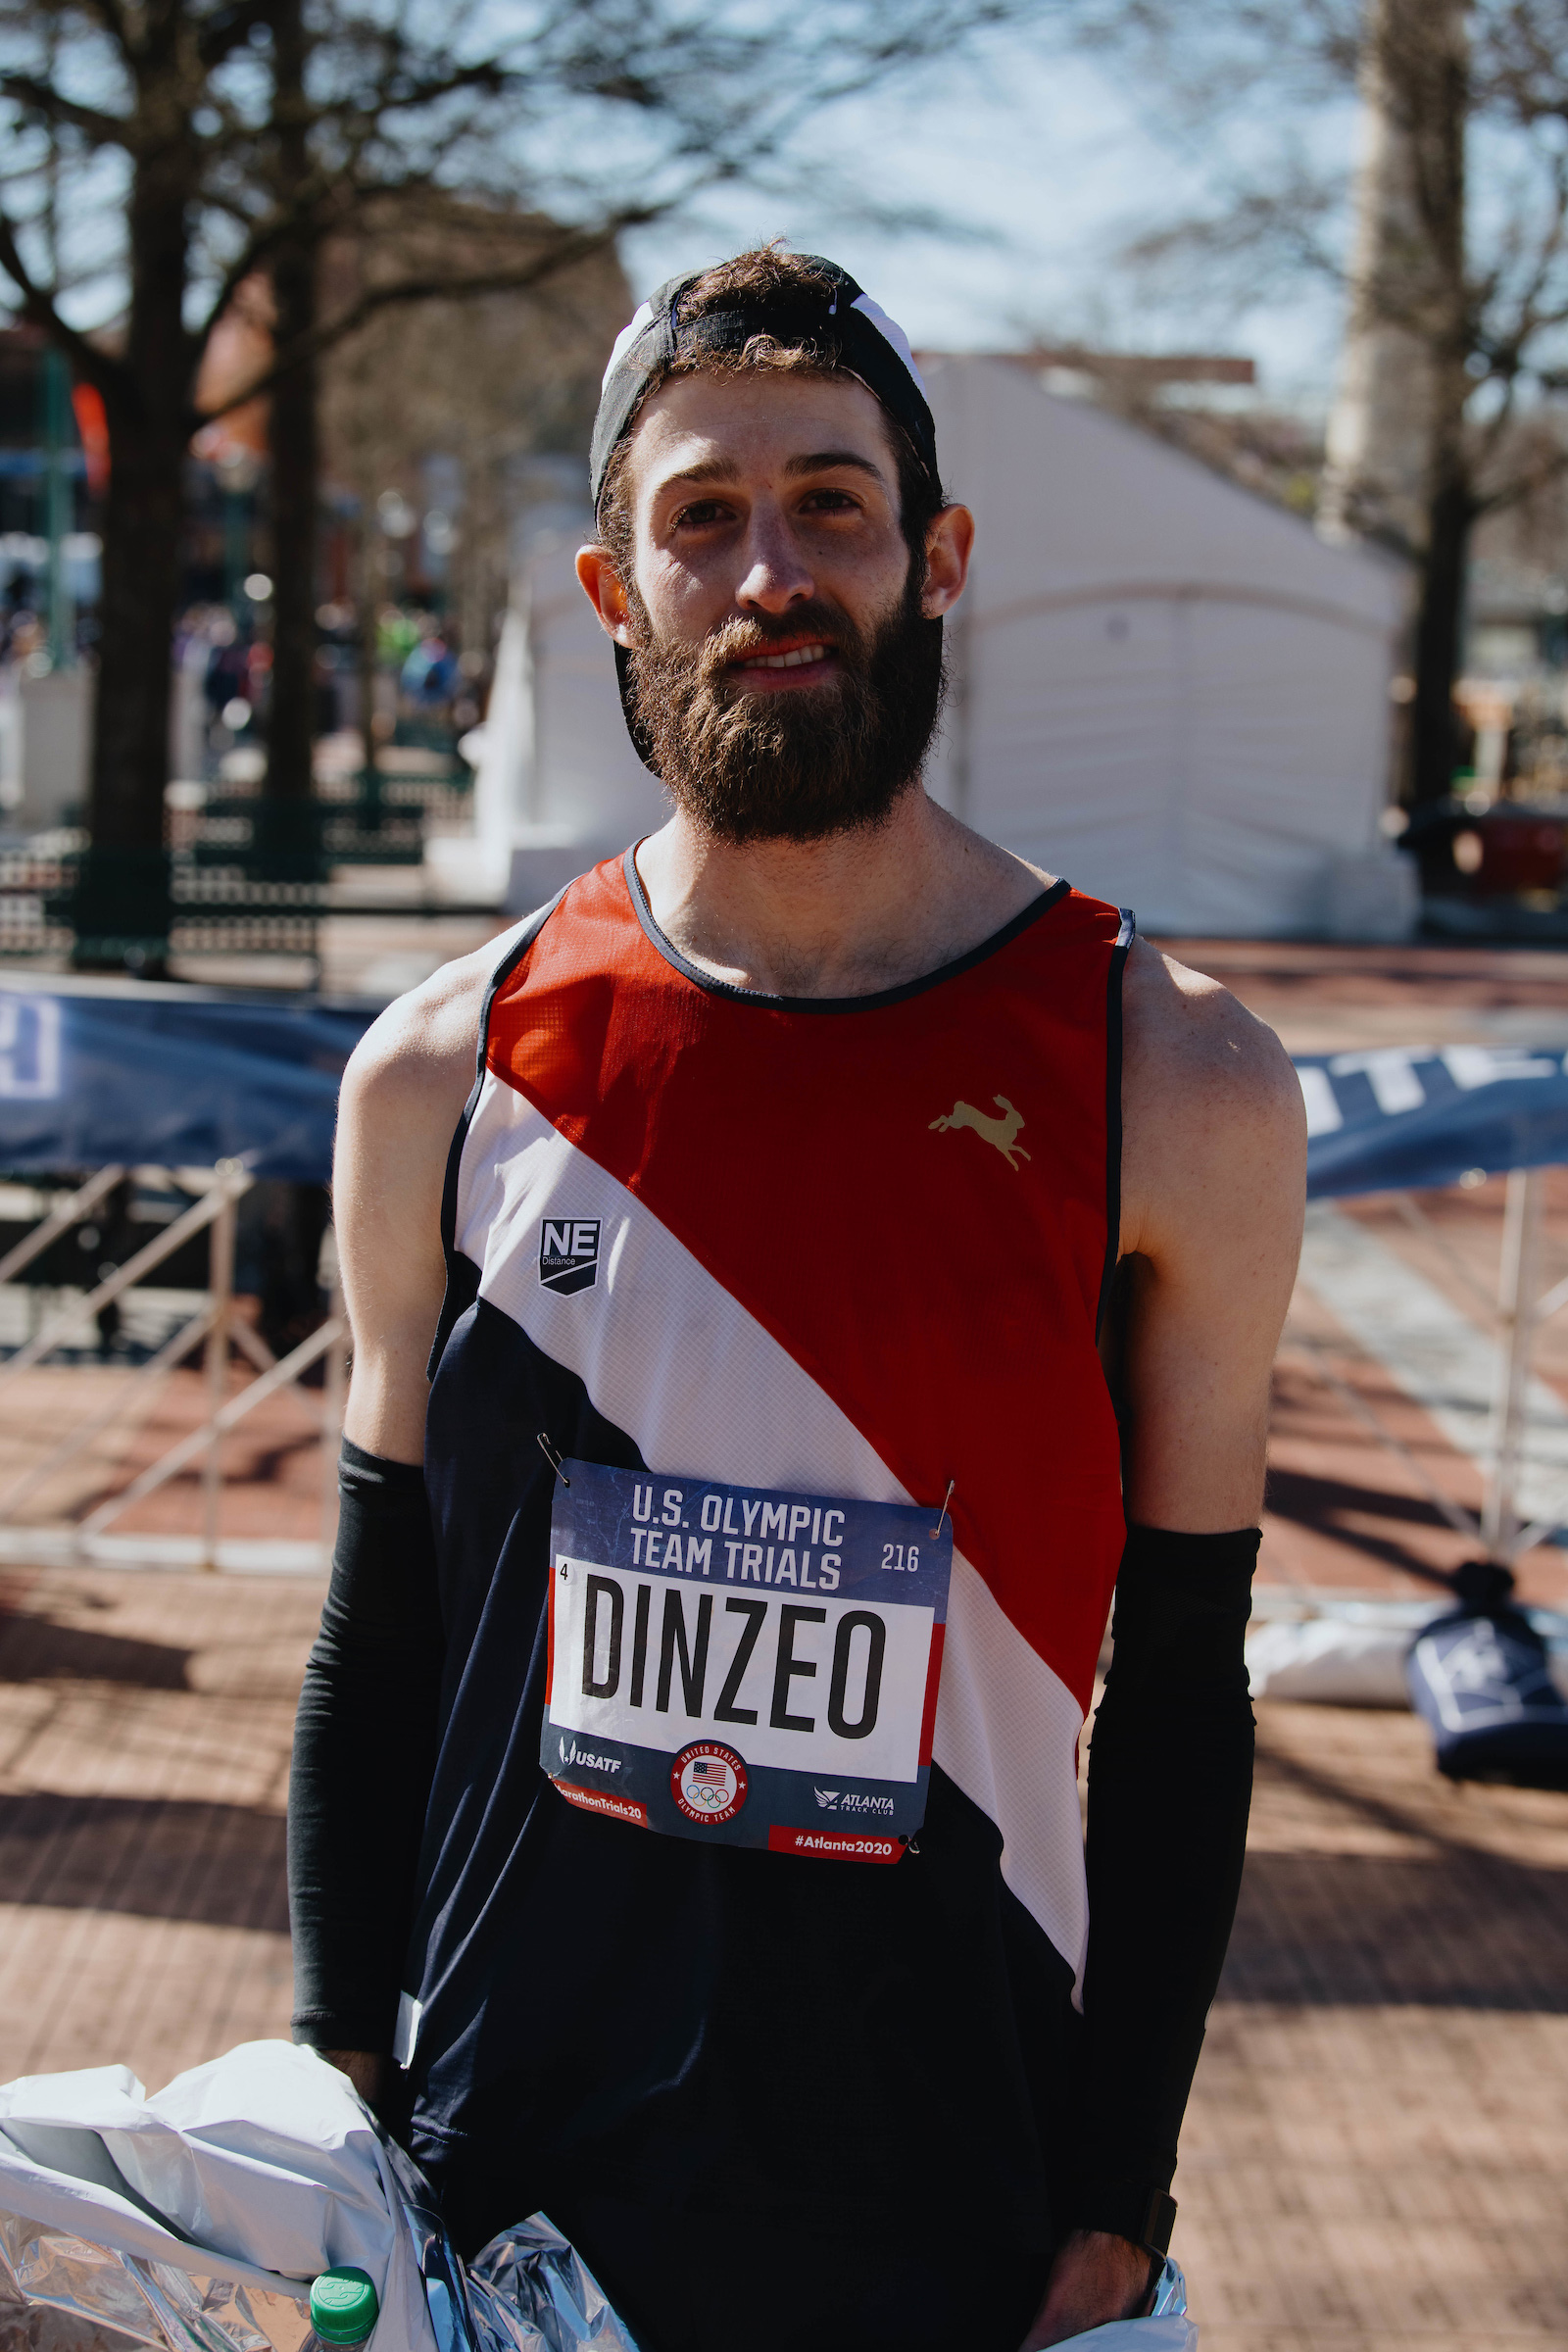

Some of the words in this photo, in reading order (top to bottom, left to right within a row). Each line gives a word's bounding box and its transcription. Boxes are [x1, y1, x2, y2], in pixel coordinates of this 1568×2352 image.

[542, 1222, 598, 1256] NE
[542, 1256, 576, 1265] Distance
[632, 1484, 689, 1528] U.S.
[700, 1494, 845, 1547] OLYMPIC
[630, 1527, 713, 1576] TEAM
[724, 1541, 842, 1591] TRIALS
[881, 1543, 920, 1573] 216
[560, 1562, 568, 1581] 4
[581, 1573, 887, 1740] DINZEO
[575, 1751, 621, 1773] USATF
[680, 1745, 710, 1763] UNITED
[713, 1747, 741, 1771] STATES
[677, 1797, 710, 1822] OLYMPIC
[714, 1806, 736, 1822] TEAM
[840, 1804, 867, 1813] TRACK
[841, 1793, 895, 1810] ATLANTA
[795, 1835, 892, 1855] #Atlanta2020
